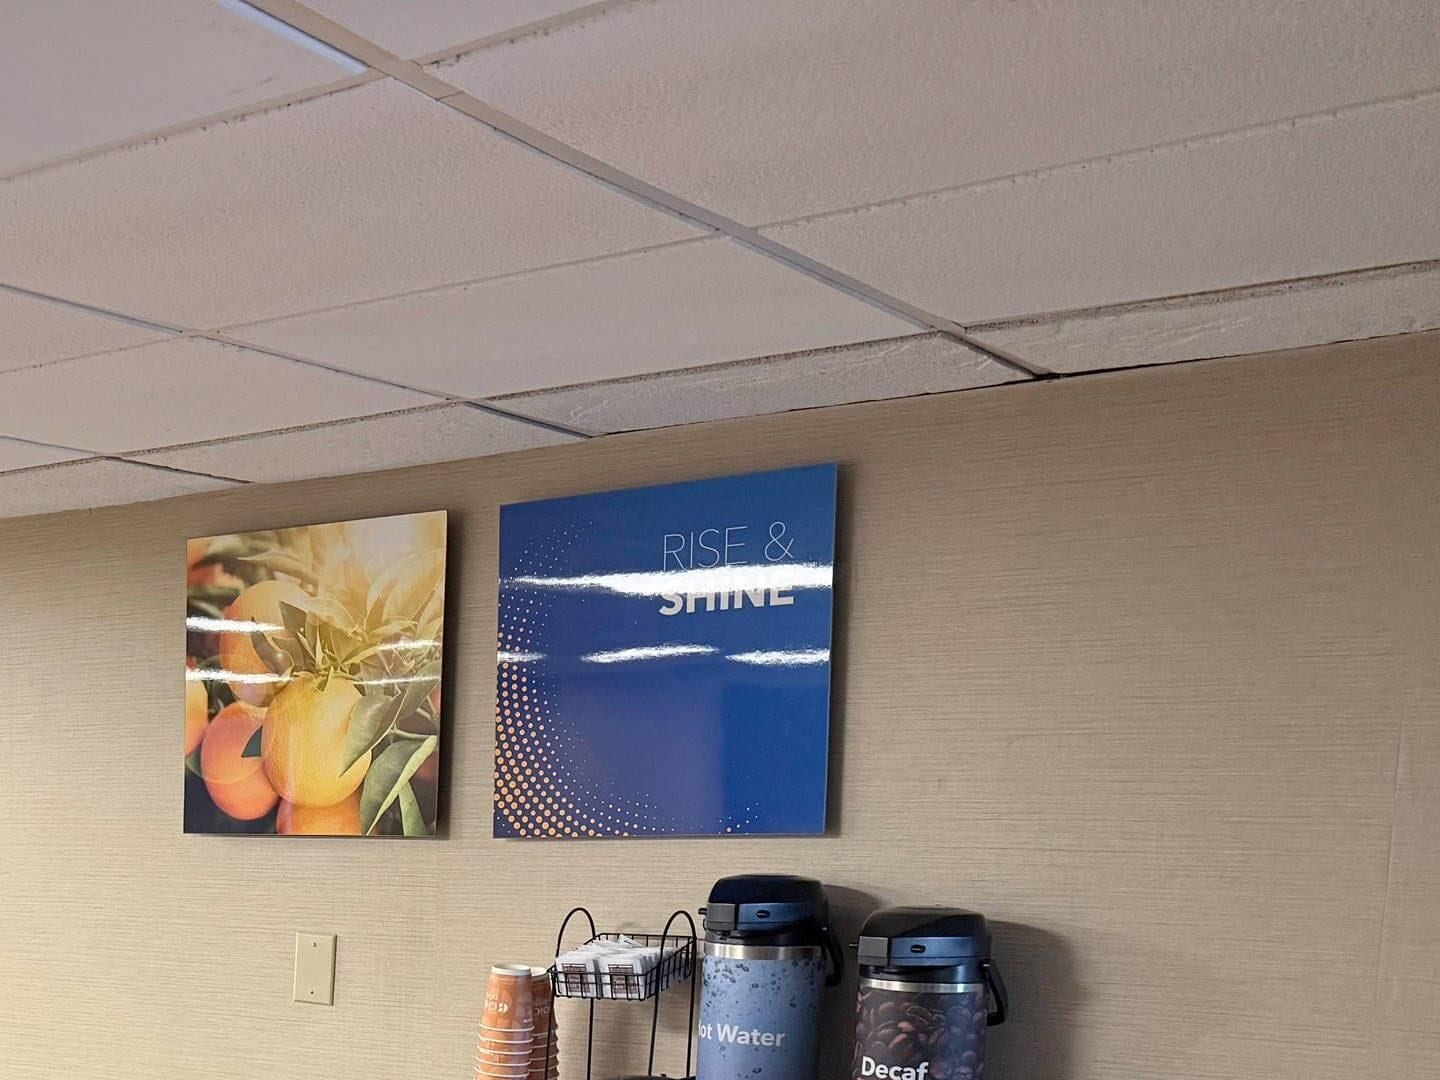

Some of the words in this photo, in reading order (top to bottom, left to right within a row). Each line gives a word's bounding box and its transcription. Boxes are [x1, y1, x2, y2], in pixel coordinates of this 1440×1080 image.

[663, 525, 748, 572] RISE
[764, 520, 795, 563] &
[659, 582, 795, 616] SHINE
[716, 1023, 786, 1047] Water
